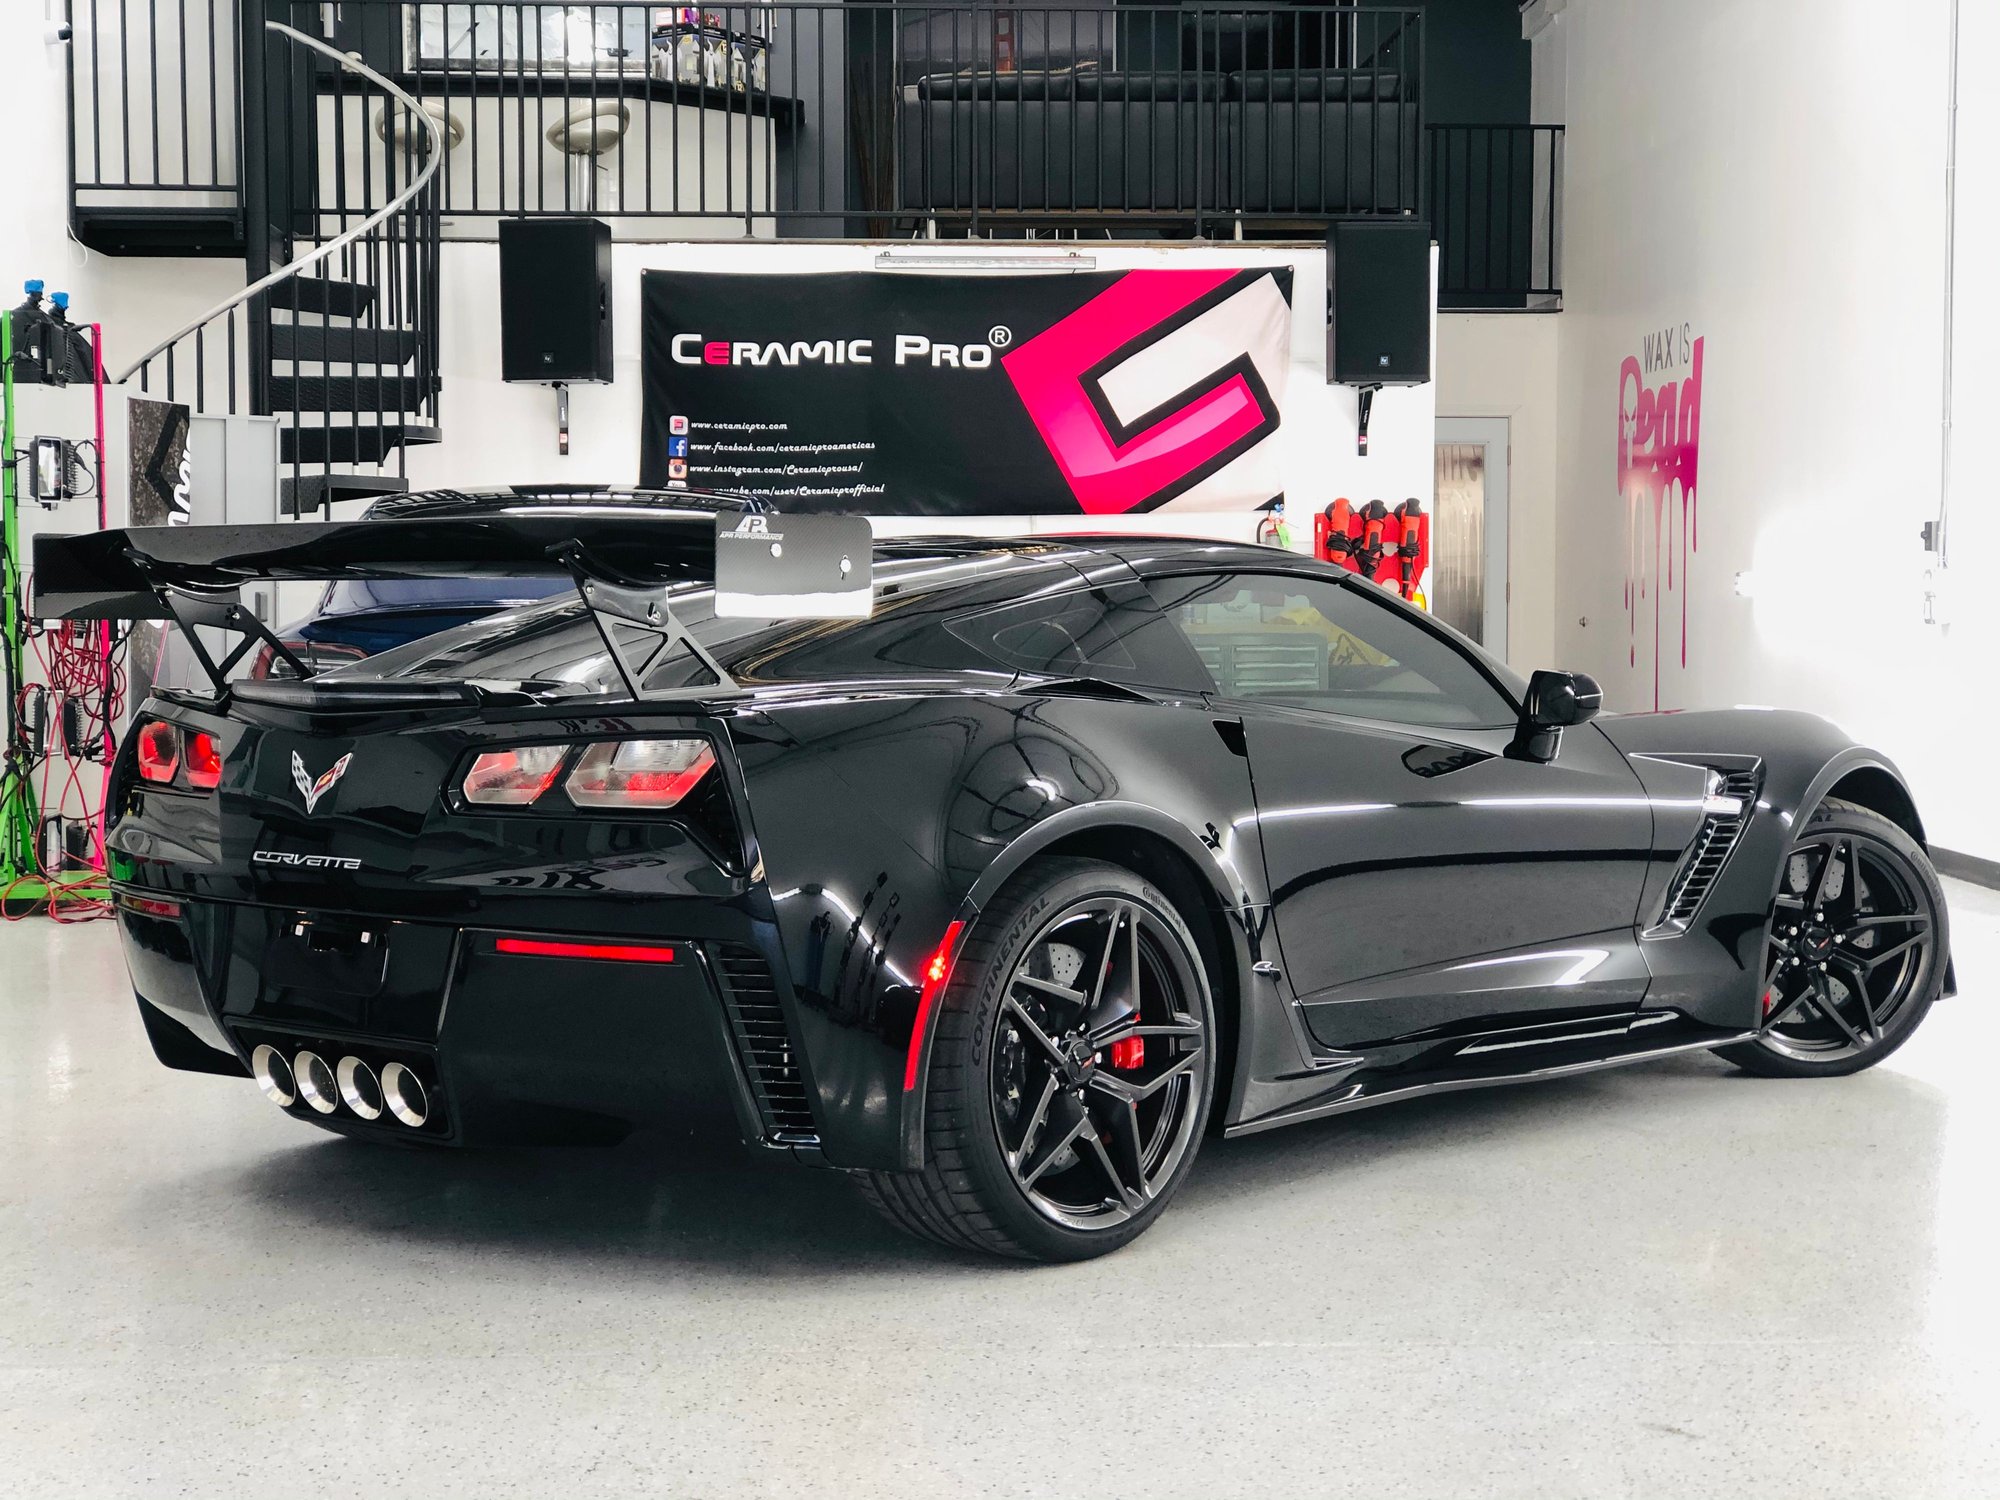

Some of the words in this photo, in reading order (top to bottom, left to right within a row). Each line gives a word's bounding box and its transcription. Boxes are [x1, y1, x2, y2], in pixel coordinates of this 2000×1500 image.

[671, 333, 872, 365] CERAMIC
[1643, 328, 1674, 373] WAX
[1679, 322, 1690, 365] IS
[691, 422, 788, 433] www.ceramicpro.com
[690, 442, 875, 454] www.facebook.com/ceramicproamericas
[690, 462, 864, 476] www.instagram.com/Ceramicprousa/
[252, 850, 362, 870] CORVETTE
[972, 897, 1050, 1067] CONTINENTAL
